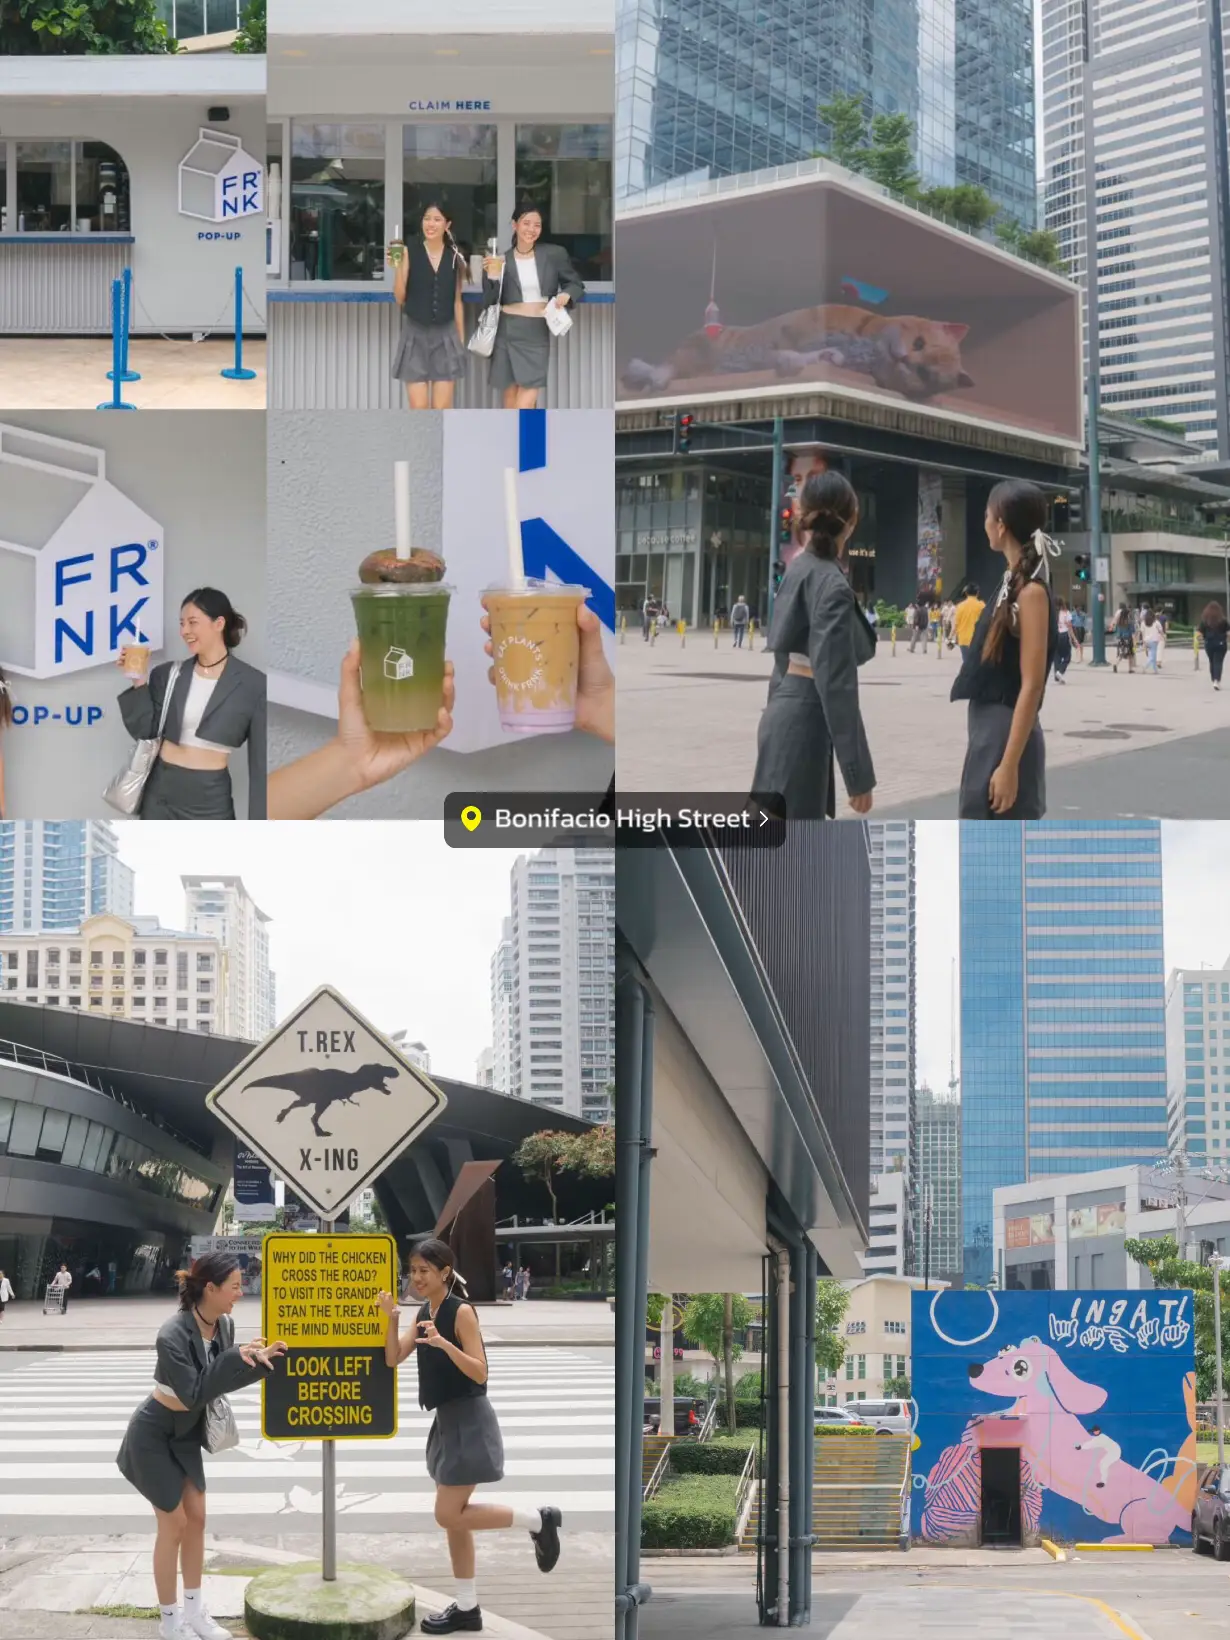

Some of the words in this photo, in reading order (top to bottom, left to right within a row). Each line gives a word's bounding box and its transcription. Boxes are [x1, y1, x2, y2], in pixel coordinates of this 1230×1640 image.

[409, 101, 450, 110] CLAIM
[456, 101, 491, 110] HERE
[222, 191, 259, 217] NK
[198, 232, 242, 240] POP-UP
[54, 596, 151, 664] NK
[508, 636, 542, 661] PLANTS
[499, 667, 520, 691] DRINK
[11, 705, 103, 726] OP-UP
[297, 1030, 356, 1053] T.REX
[299, 1148, 359, 1171] X-ING
[272, 1251, 296, 1264] WHY
[300, 1251, 317, 1264] DID
[320, 1251, 338, 1264] THE
[341, 1251, 387, 1264] CHICKEN
[281, 1269, 317, 1282] CROSS
[320, 1269, 340, 1282] THE
[343, 1269, 377, 1282] ROAD?
[273, 1286, 287, 1300] TO
[289, 1286, 314, 1300] VISIT
[317, 1286, 333, 1300] ITS
[278, 1304, 307, 1318] STAN
[310, 1304, 331, 1318] THE
[334, 1304, 364, 1318] T.REX
[367, 1304, 380, 1318] AT
[276, 1322, 298, 1336] THE
[301, 1322, 329, 1336] MIND
[332, 1322, 384, 1336] MUSEUM.
[286, 1356, 331, 1377] LOOK
[334, 1356, 372, 1376] LEFT
[298, 1381, 361, 1401] BEFORE
[287, 1405, 372, 1427] CROSSING
